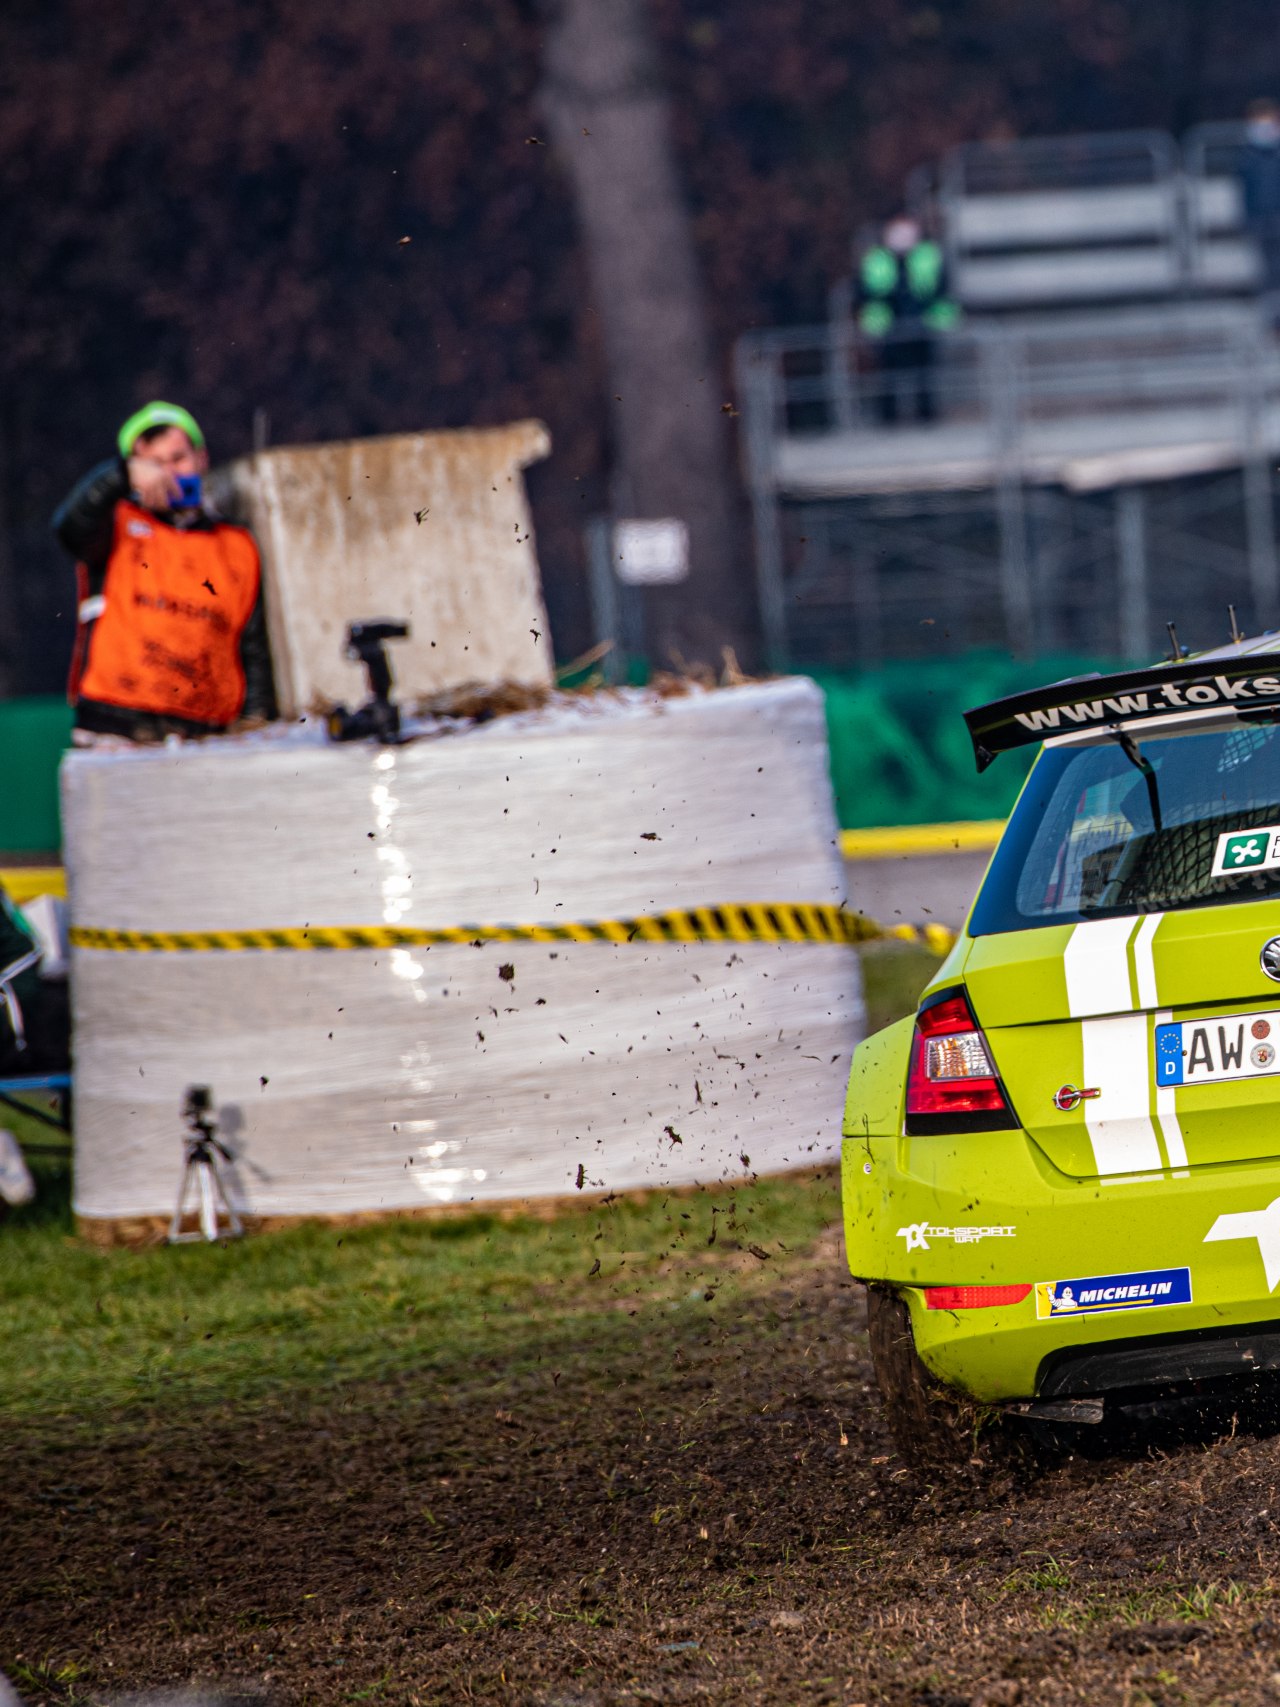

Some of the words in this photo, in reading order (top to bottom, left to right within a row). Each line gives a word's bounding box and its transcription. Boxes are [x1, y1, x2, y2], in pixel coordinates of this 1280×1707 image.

[1187, 1023, 1245, 1075] AW
[1165, 1061, 1176, 1076] D
[1078, 1281, 1173, 1304] MICHELIN
